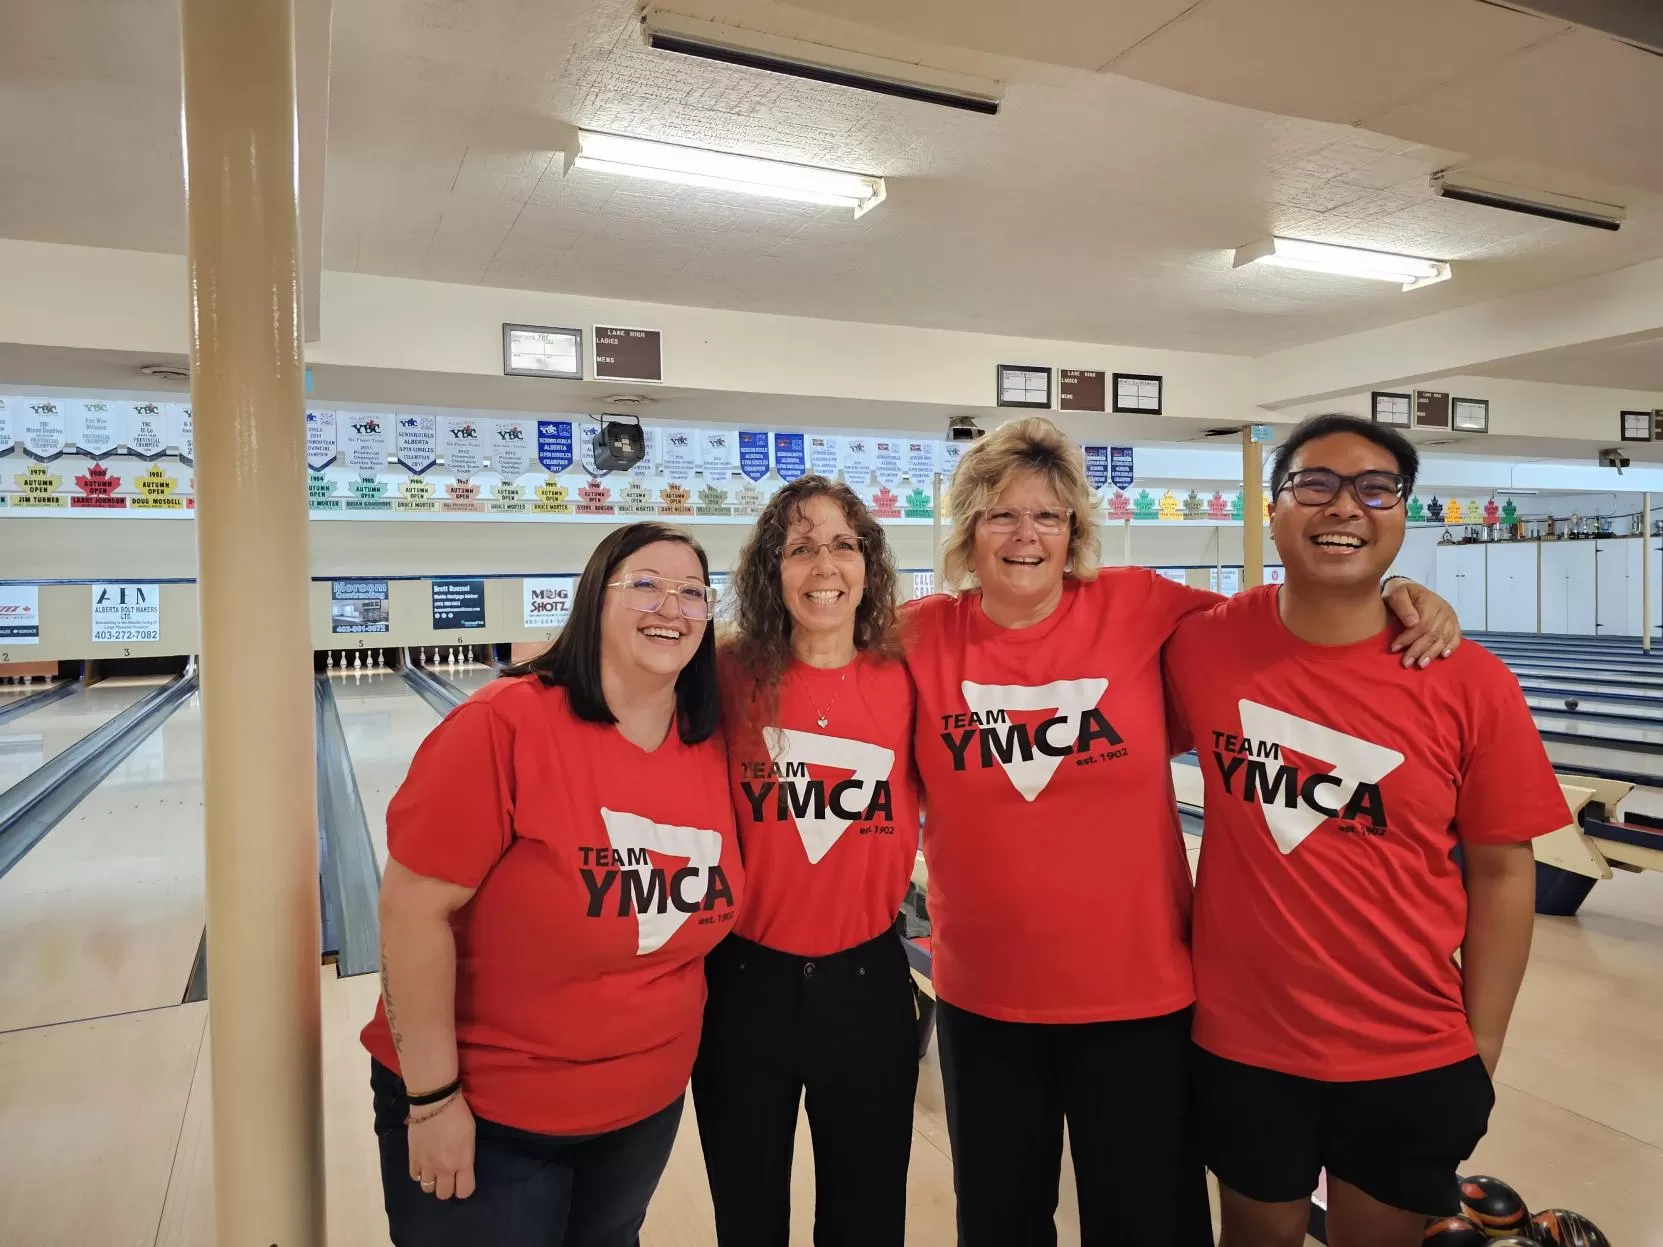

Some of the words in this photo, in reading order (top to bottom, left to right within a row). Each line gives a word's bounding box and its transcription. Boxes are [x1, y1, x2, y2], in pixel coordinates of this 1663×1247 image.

[30, 403, 58, 414] YBC
[84, 403, 108, 412] YBC
[133, 404, 159, 415] YBC
[351, 422, 381, 434] YBC
[449, 426, 477, 439] YBC
[540, 424, 558, 435] YBC
[497, 428, 524, 441] YBC
[433, 585, 448, 593] Brett
[531, 589, 568, 600] MUG
[530, 600, 569, 613] SHOTZ
[95, 630, 158, 640] 403-272-7082
[457, 636, 463, 644] 6
[546, 632, 552, 641] 7
[358, 639, 364, 647] 5
[2, 652, 10, 662] 2
[124, 648, 130, 657] 3
[941, 708, 1007, 731] TEAM
[940, 707, 1124, 772] YMCA
[1212, 730, 1280, 760] TEAM
[1076, 755, 1098, 766] est.
[1100, 747, 1129, 761] 1902
[741, 761, 805, 779] TEAM
[1212, 750, 1388, 829] YMCA
[739, 779, 894, 822] YMCA
[874, 825, 895, 835] 1902
[578, 846, 648, 867] TEAM
[579, 865, 734, 918] YMCA
[698, 916, 715, 926] est.
